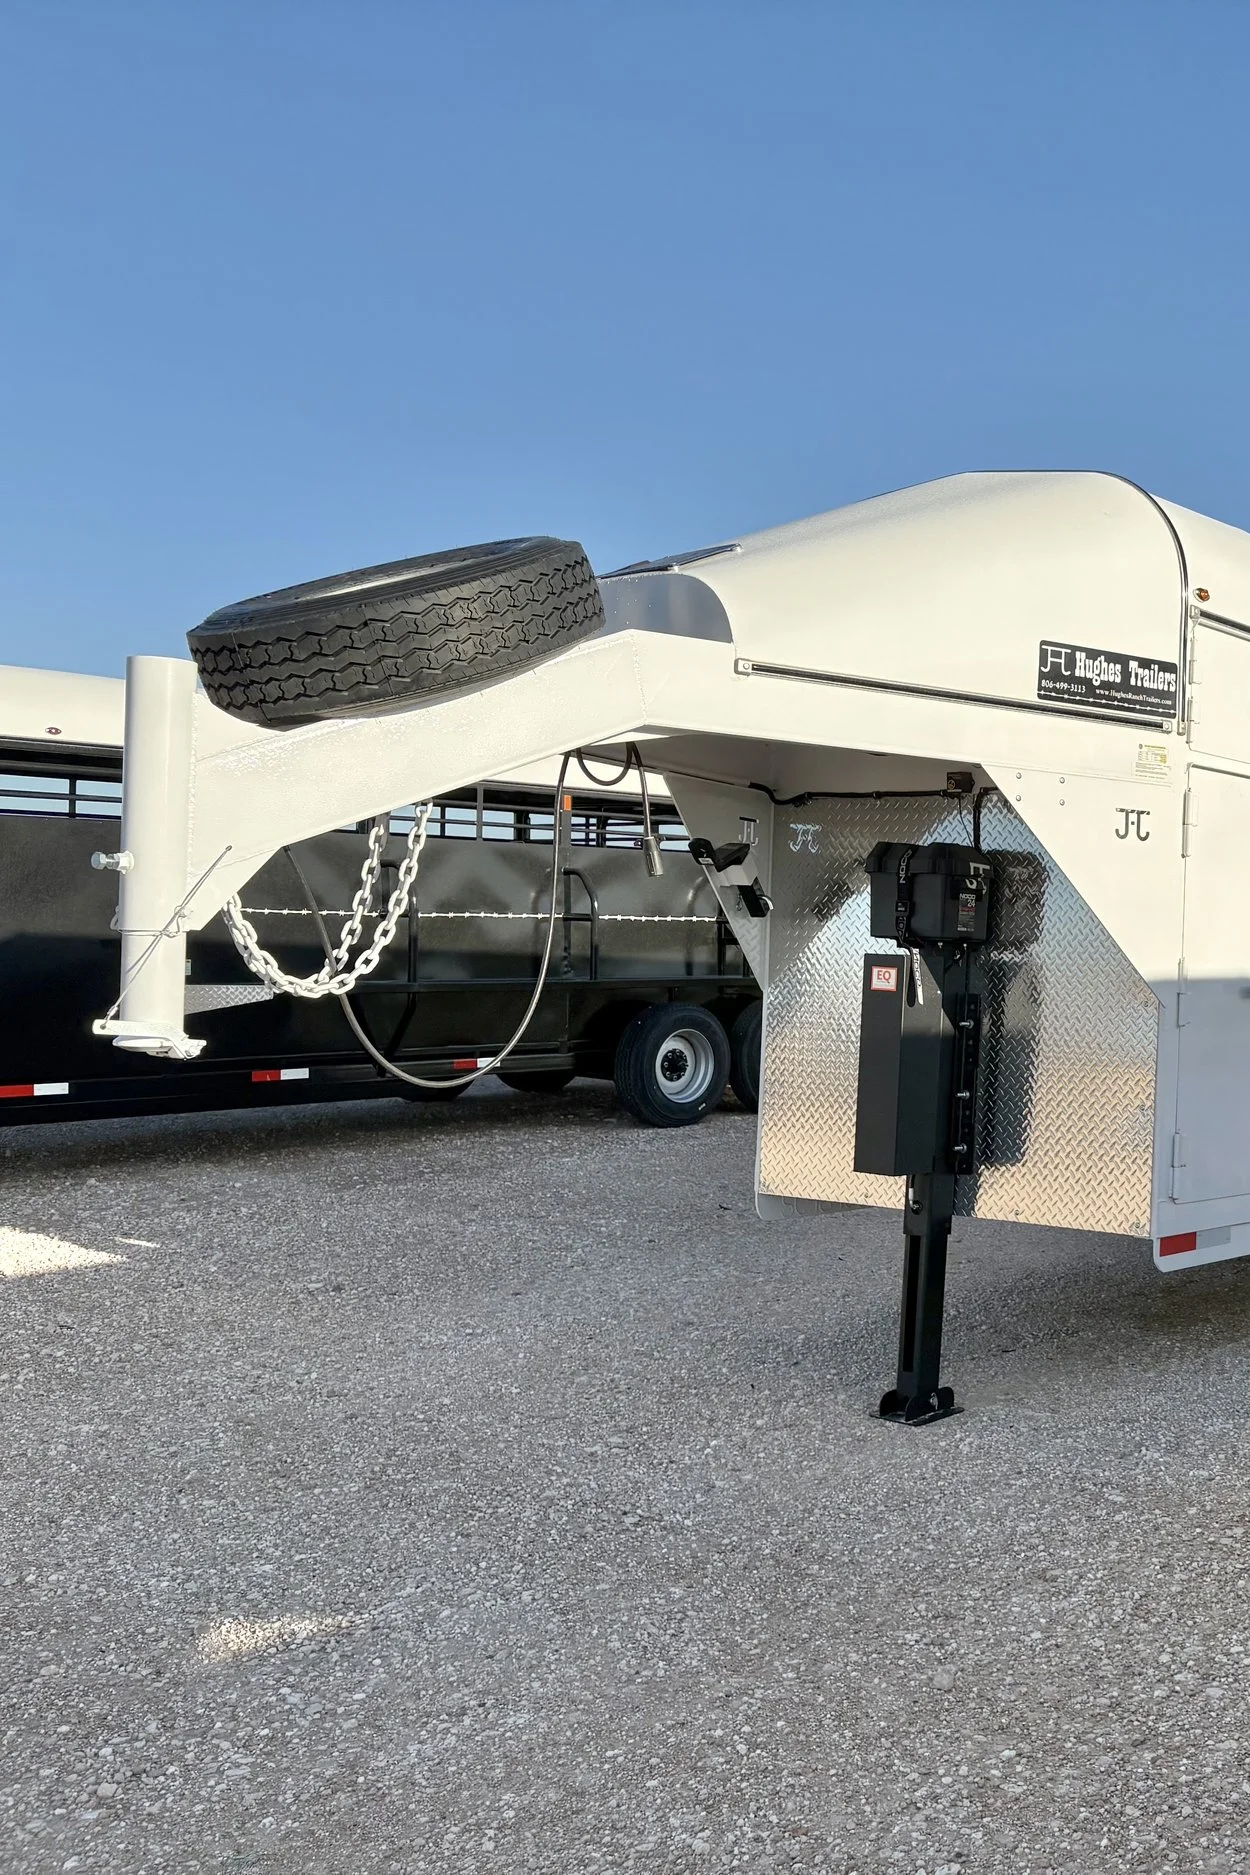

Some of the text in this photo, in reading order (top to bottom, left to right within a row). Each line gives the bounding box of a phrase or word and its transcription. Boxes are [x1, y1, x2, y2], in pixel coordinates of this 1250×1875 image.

[1074, 651, 1177, 692] Hughes Trailers
[1041, 679, 1086, 693] 806-499-3113
[899, 848, 912, 884] NOCO
[877, 969, 892, 984] EQ
